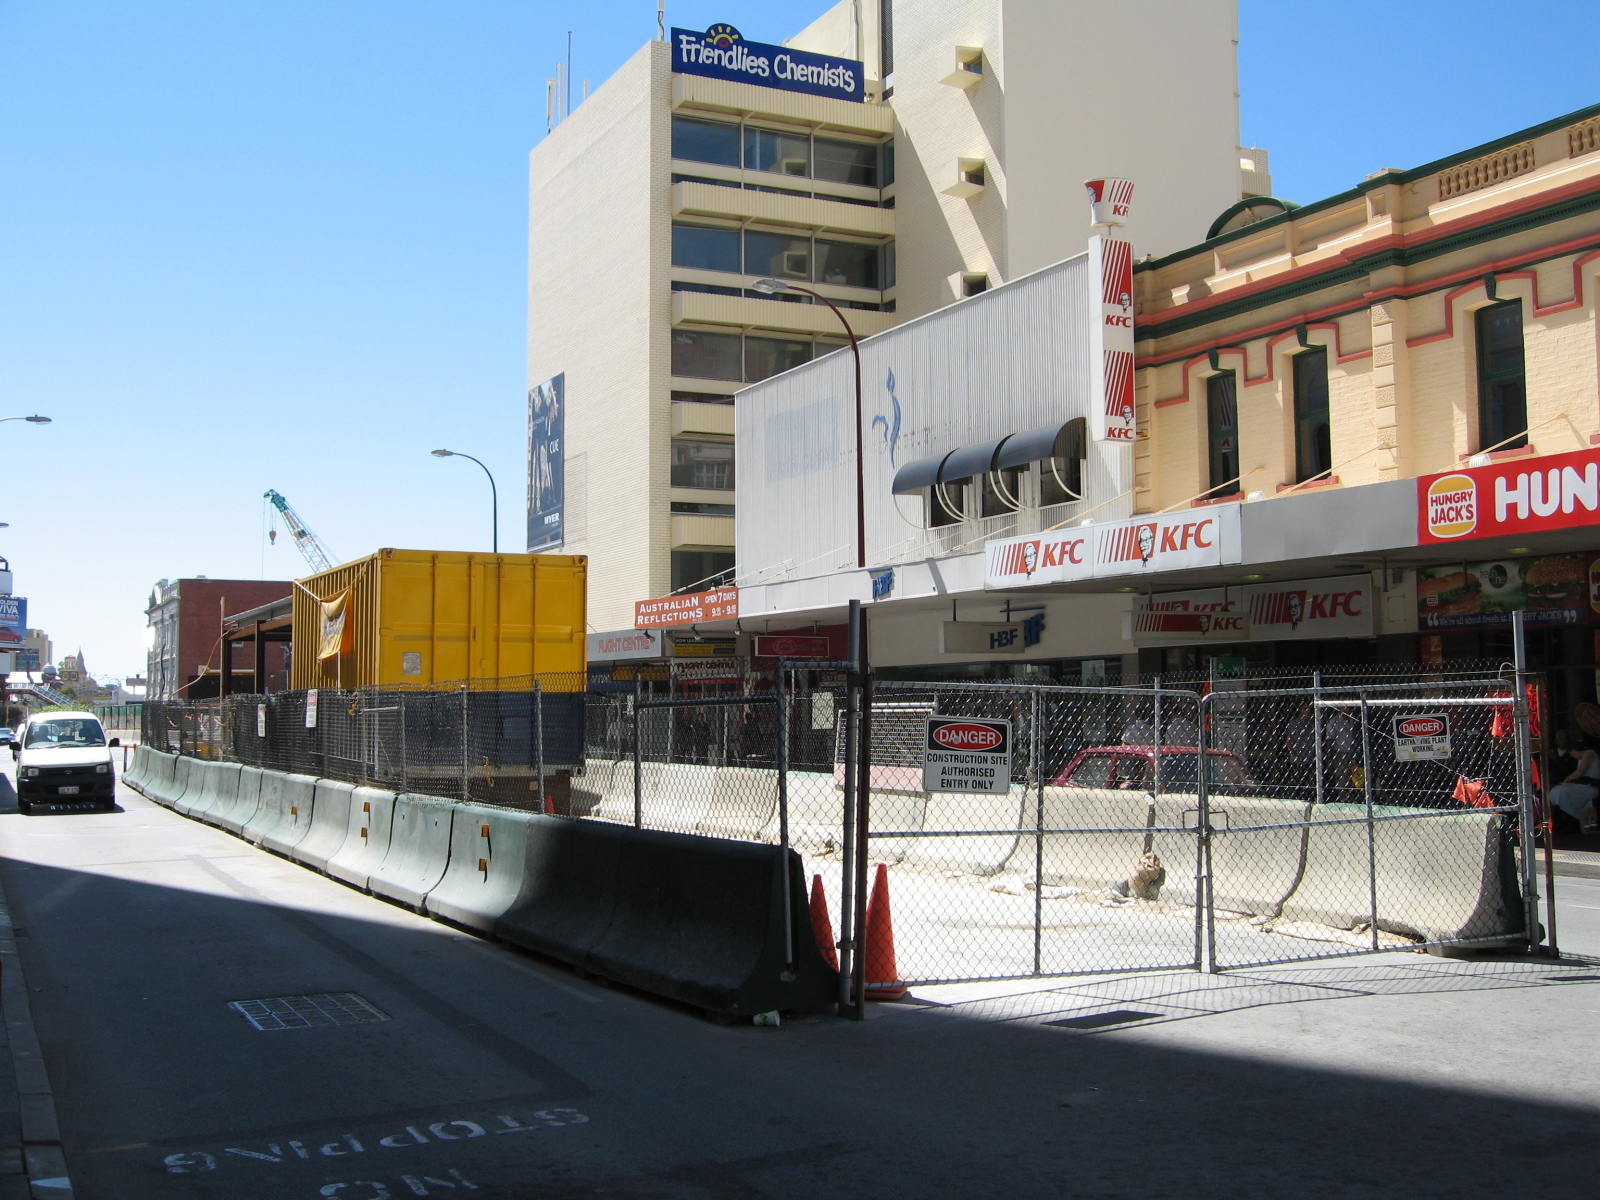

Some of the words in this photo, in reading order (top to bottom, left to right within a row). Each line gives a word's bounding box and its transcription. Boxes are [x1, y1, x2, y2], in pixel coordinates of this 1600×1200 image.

[679, 35, 770, 77] Friendlies
[773, 54, 856, 92] Chemists
[1105, 314, 1132, 328] KFC
[1106, 426, 1134, 439] KFC
[549, 438, 560, 454] CUE
[1430, 490, 1474, 507] HUNGRY
[1494, 462, 1600, 523] HUN
[544, 512, 560, 525] MYER
[1431, 504, 1474, 525] JACK'S
[1160, 519, 1213, 553] KFC
[1041, 539, 1085, 568] KFC
[640, 596, 699, 614] AUSTRALIAN
[705, 594, 718, 604] OPEN
[718, 592, 723, 604] 7
[723, 591, 737, 601] DAYS
[1309, 590, 1363, 619] KFC
[637, 608, 703, 625] REFLECTIONS
[1213, 617, 1243, 630] KFC
[1456, 616, 1464, 624] all
[1465, 616, 1482, 624] about
[1482, 614, 1499, 623] fresh
[990, 628, 1018, 649] HBF
[1023, 613, 1045, 648] BF
[598, 638, 621, 654] FLIGHT
[622, 636, 650, 652] CENTRE
[1402, 722, 1440, 733] DANGER
[939, 729, 996, 745] DANGER
[927, 753, 988, 765] CONSTRUCTION
[991, 755, 1008, 765] SITE
[941, 766, 995, 778] AUTHORISED
[941, 778, 969, 789] ENTRY
[972, 779, 994, 789] ONLY
[162, 1108, 590, 1174] STOPPING
